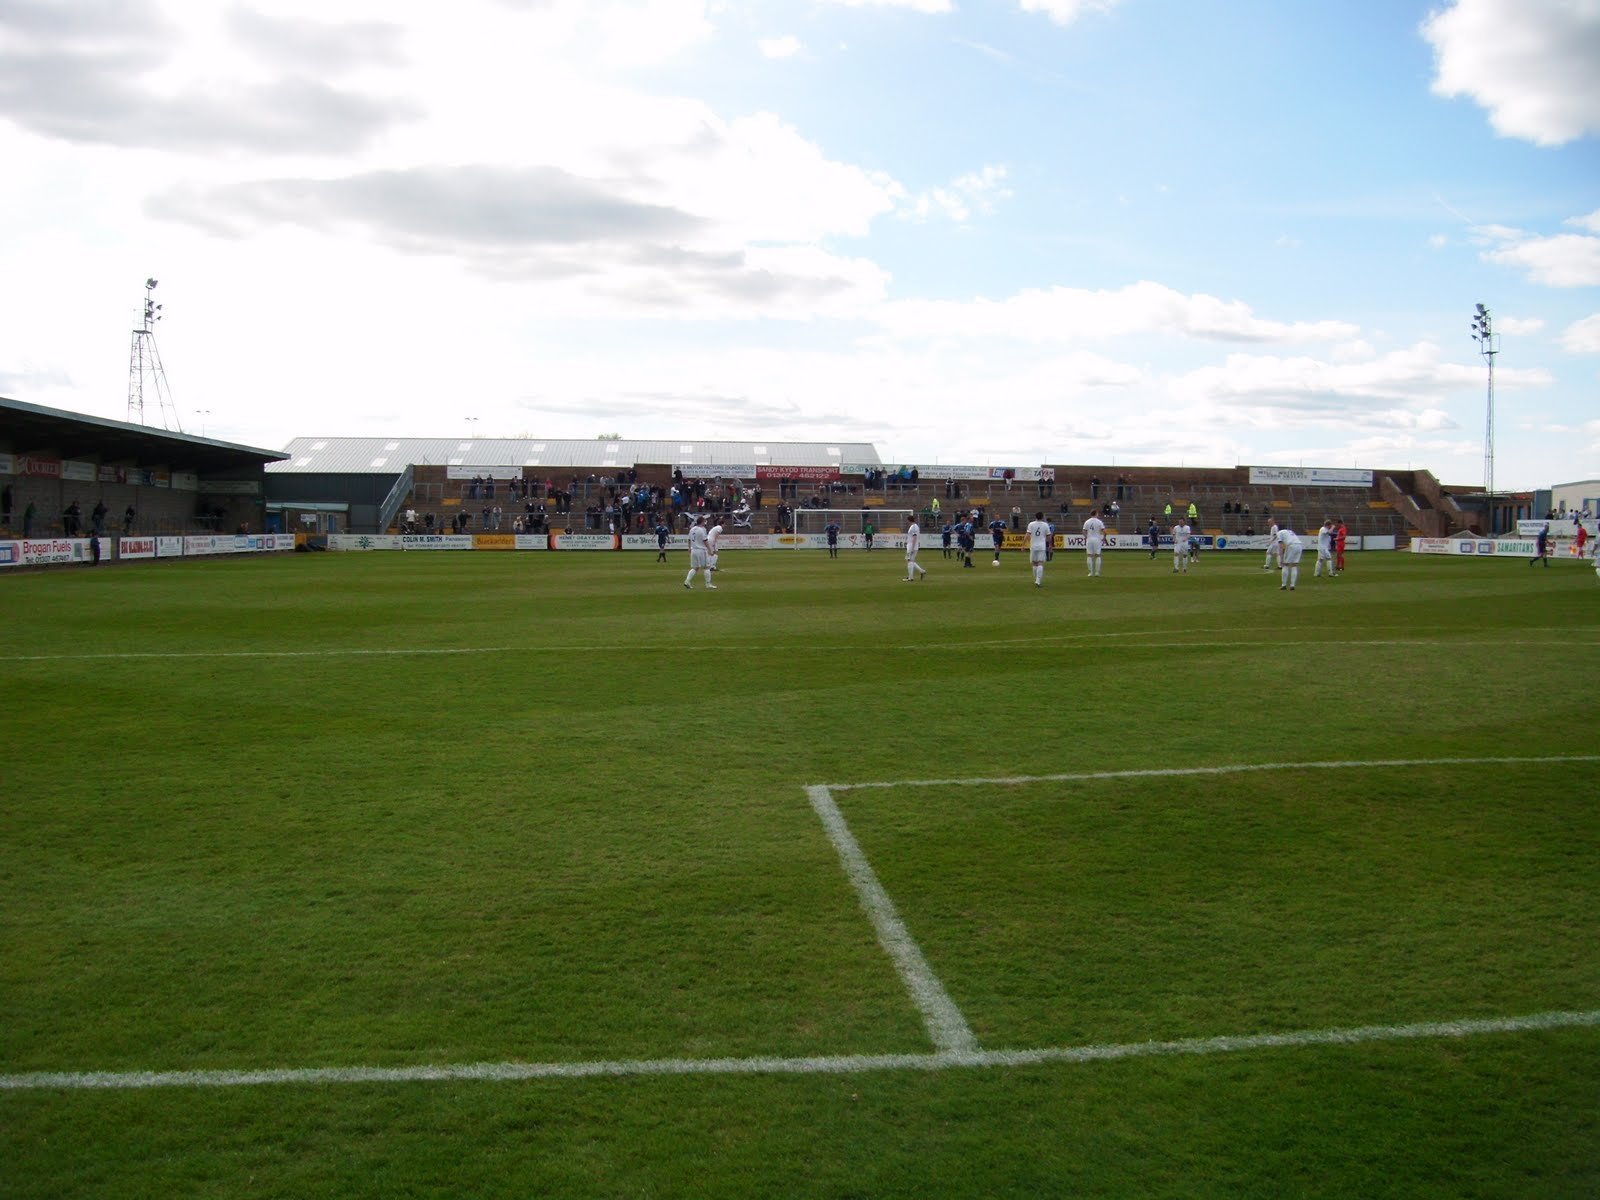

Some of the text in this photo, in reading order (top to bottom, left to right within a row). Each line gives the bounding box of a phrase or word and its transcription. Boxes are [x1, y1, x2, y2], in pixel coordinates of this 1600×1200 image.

[1035, 527, 1041, 537] 6
[1089, 523, 1094, 531] 4
[626, 536, 639, 544] The
[639, 536, 656, 544] Press
[23, 540, 72, 556] Brogan Fuels
[1497, 541, 1534, 553] SAMARITANS
